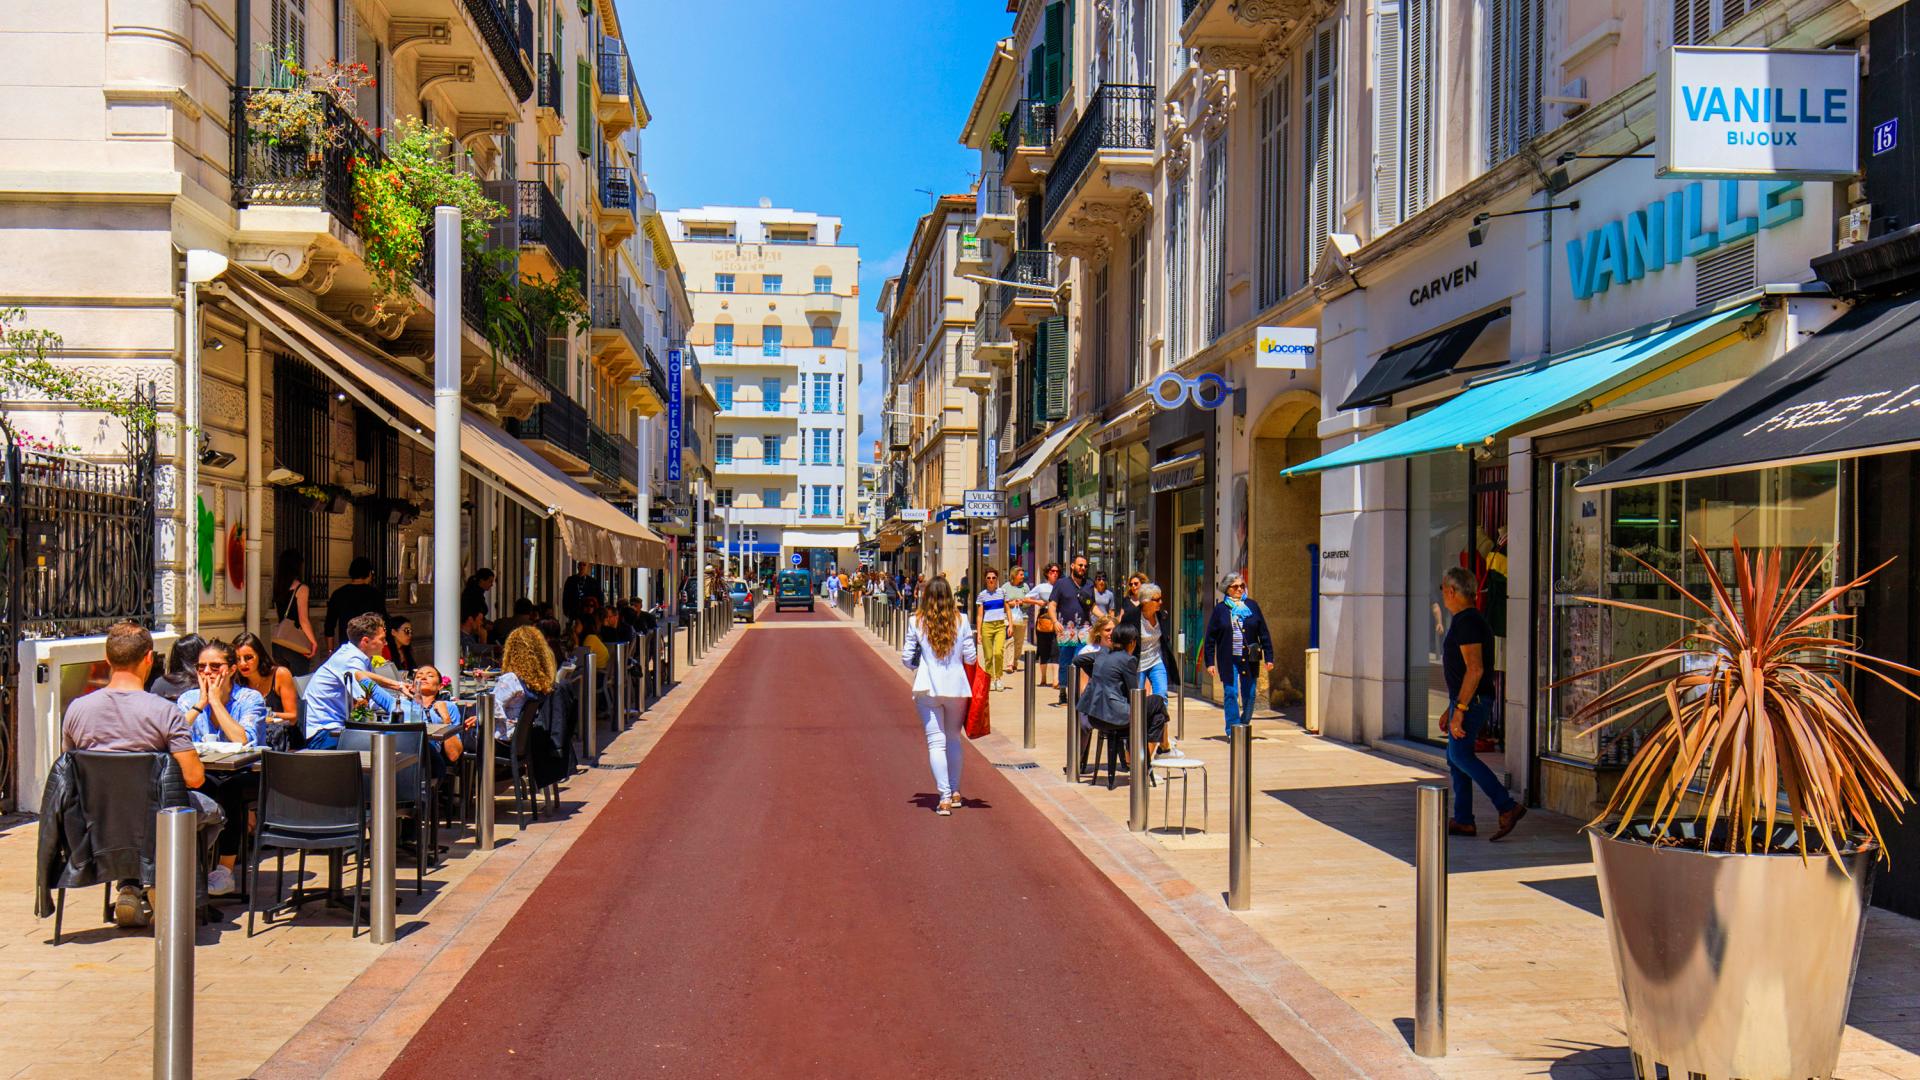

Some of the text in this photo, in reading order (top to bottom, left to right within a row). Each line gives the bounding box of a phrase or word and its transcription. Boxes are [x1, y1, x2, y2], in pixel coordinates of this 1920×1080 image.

[1681, 85, 1848, 124] VANILLE
[1727, 131, 1798, 146] BIJOUX
[1875, 122, 1893, 152] 15
[1566, 179, 1804, 301] VANILLE
[1409, 260, 1478, 307] CARVEN
[1268, 344, 1315, 354] LOCOPRO
[670, 353, 680, 478] HOTEL FLORIAN
[1743, 390, 1892, 437] FREE
[968, 502, 1002, 510] CROISETTE
[972, 492, 999, 500] VILLAGE
[1322, 550, 1350, 559] CARVEN
